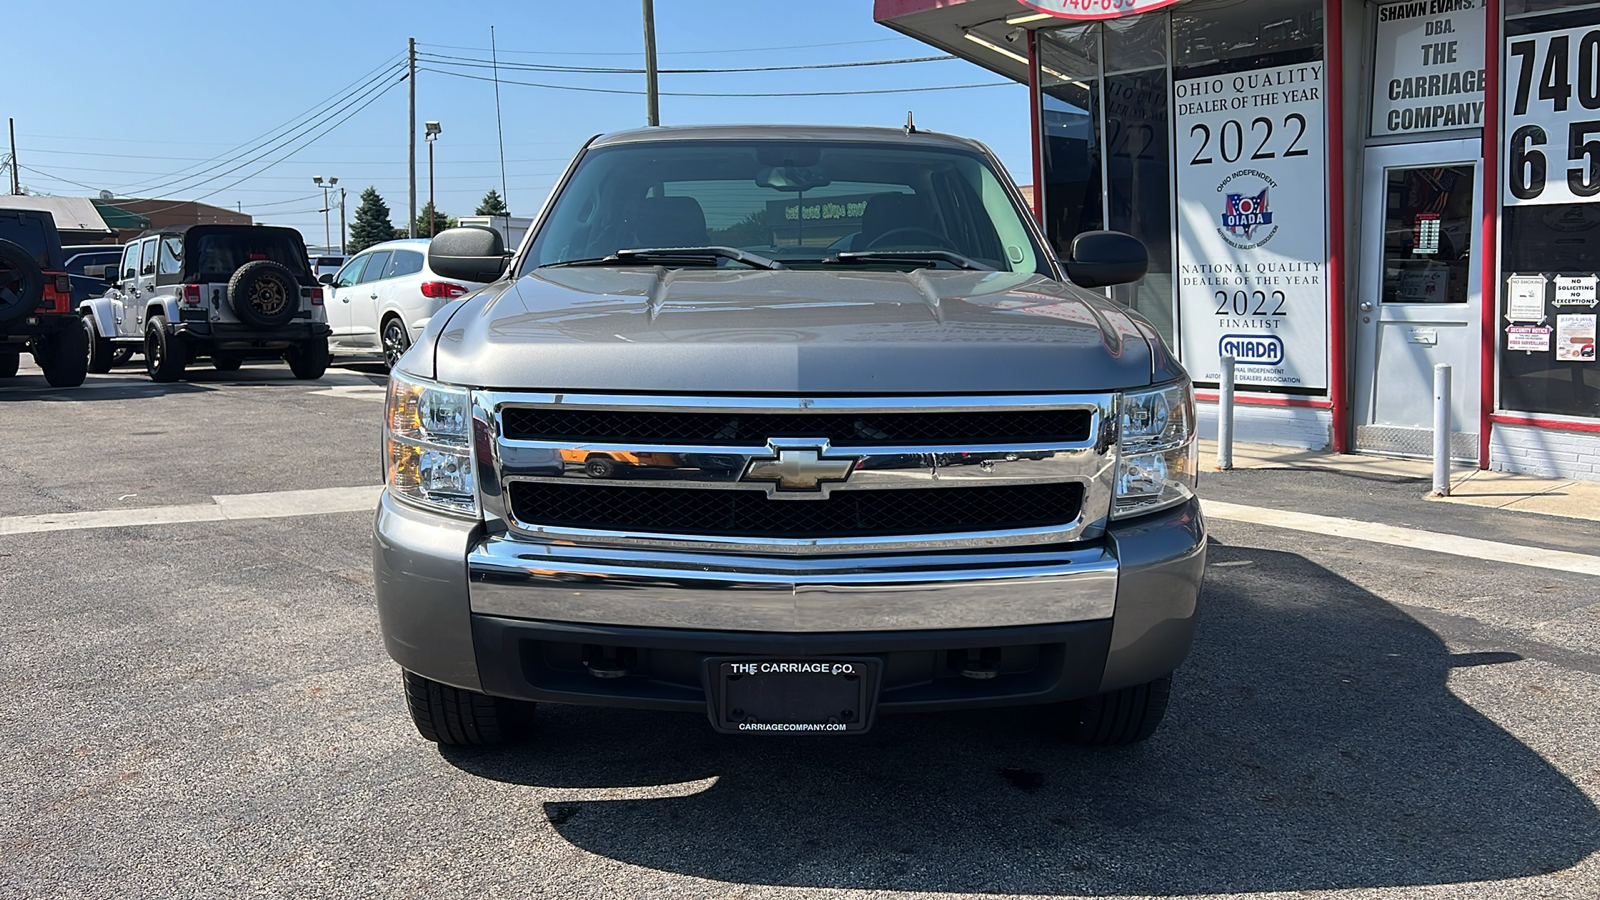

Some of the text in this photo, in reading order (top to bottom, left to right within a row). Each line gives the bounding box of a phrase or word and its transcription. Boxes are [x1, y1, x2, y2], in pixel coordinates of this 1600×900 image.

[1380, 2, 1427, 22] SHAWN
[1430, 0, 1475, 15] EVANS.
[1425, 19, 1456, 37] DBA.
[1421, 41, 1458, 66] THE
[1176, 79, 1224, 98] OHIO
[1232, 66, 1322, 93] QUALITY
[1388, 69, 1485, 101] CARRIAGE
[1511, 30, 1600, 116] 740
[1179, 99, 1228, 116] DEALER
[1231, 96, 1249, 110] OF
[1251, 92, 1279, 107] THE
[1282, 87, 1320, 104] YEAR
[1387, 102, 1485, 131] COMPANY
[1189, 113, 1309, 166] 2022
[1217, 169, 1278, 193] OHIO INDEPENDENT
[1227, 213, 1264, 226] OIADA
[1216, 227, 1238, 249] AUTOMOBILE
[1256, 224, 1279, 248] ASSOCIATION
[1182, 262, 1321, 274] NATIONAL QUALITY
[1183, 275, 1320, 286] DEALER OF THE YEAR
[1214, 290, 1287, 316] 2022
[1219, 319, 1281, 329] FINALIST
[1224, 341, 1278, 359] NIADA
[731, 663, 856, 675] THE CARRIAGE CO.
[738, 722, 847, 732] CARRIAGECOMPANY.COM
